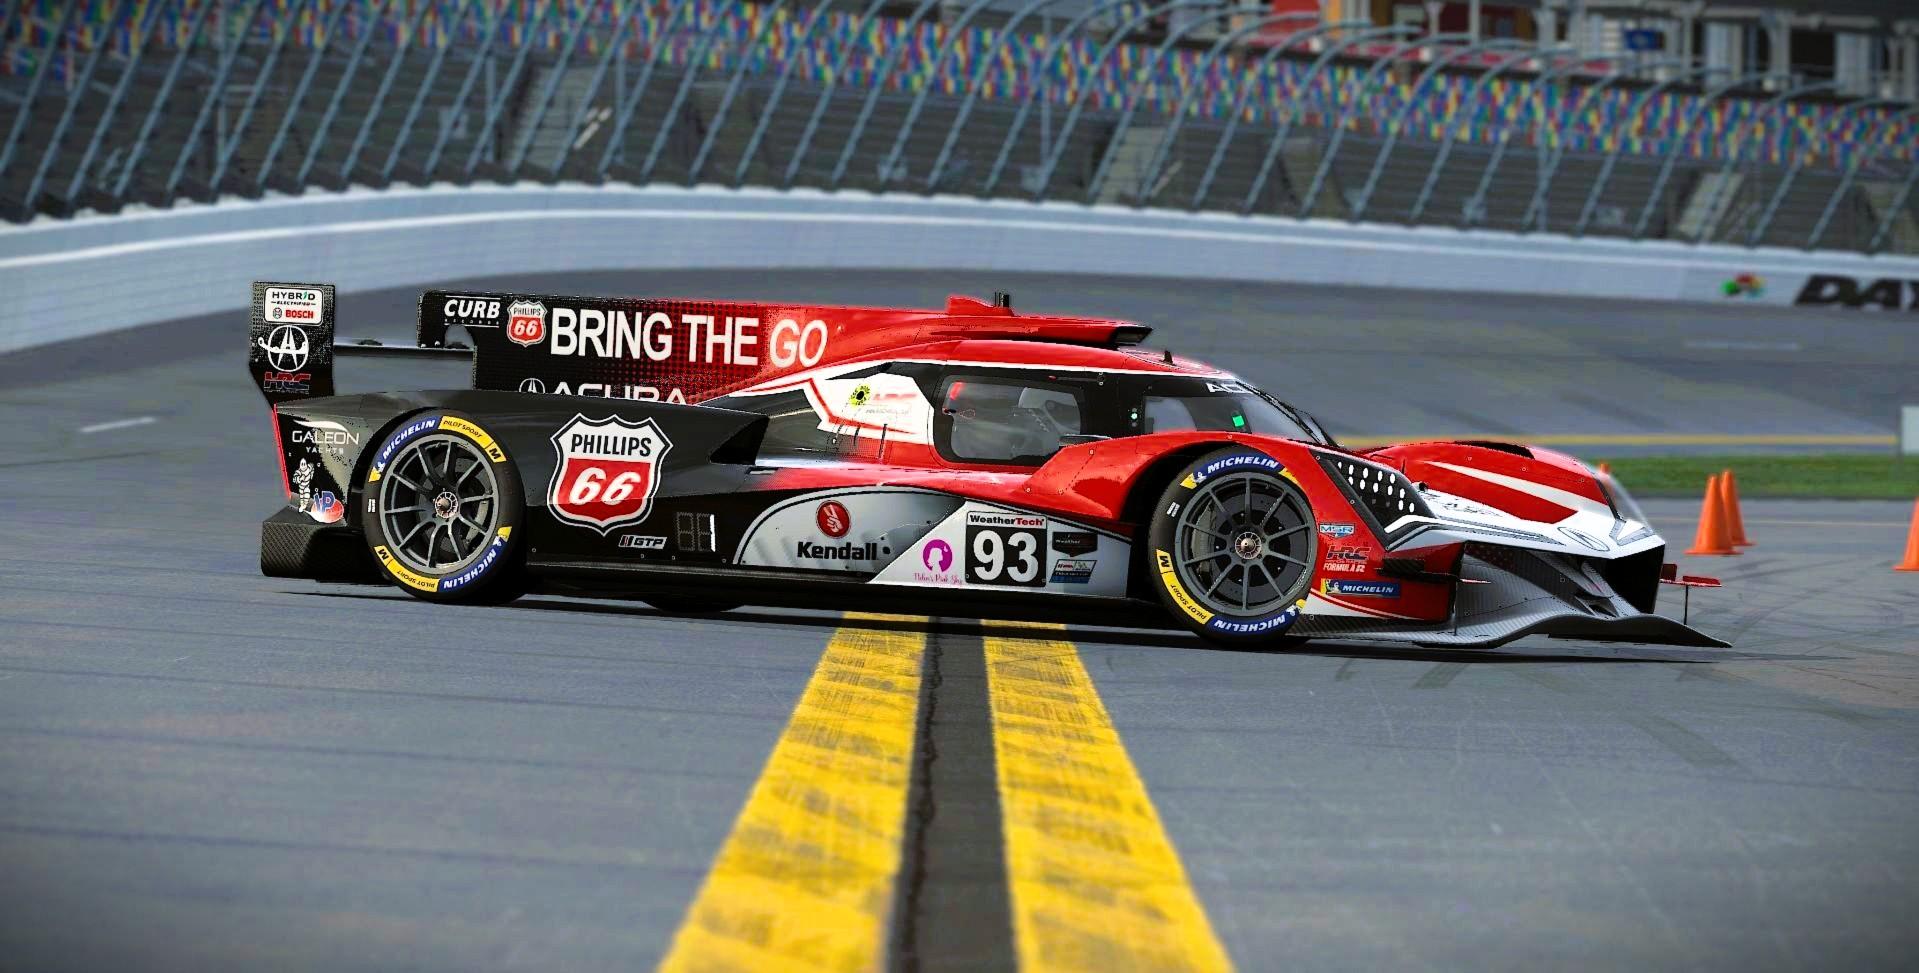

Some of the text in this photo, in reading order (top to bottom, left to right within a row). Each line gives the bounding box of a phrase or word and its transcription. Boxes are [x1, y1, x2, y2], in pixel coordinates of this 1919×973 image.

[272, 291, 316, 300] HYBRID
[285, 309, 314, 319] BOSCH
[444, 299, 500, 319] CURB
[513, 307, 541, 316] PHILLIPS
[514, 320, 538, 336] 66
[551, 308, 828, 368] BRING THE GO
[292, 430, 359, 445] GALEON
[443, 420, 483, 438] PILOT SPORT
[383, 419, 436, 460] MICHELIN
[571, 434, 652, 457] PHILLIPS
[1207, 456, 1279, 474] MICHELIN
[569, 467, 642, 506] 66
[970, 515, 1044, 527] WeatherTech
[633, 537, 664, 547] GTP
[797, 541, 877, 561] Kendall
[973, 529, 1039, 583] 93
[444, 548, 497, 589] MICHELIN
[1323, 562, 1355, 572] FORMULA
[1342, 585, 1394, 593] MICHELIN
[1214, 614, 1286, 632] MICHELIN
